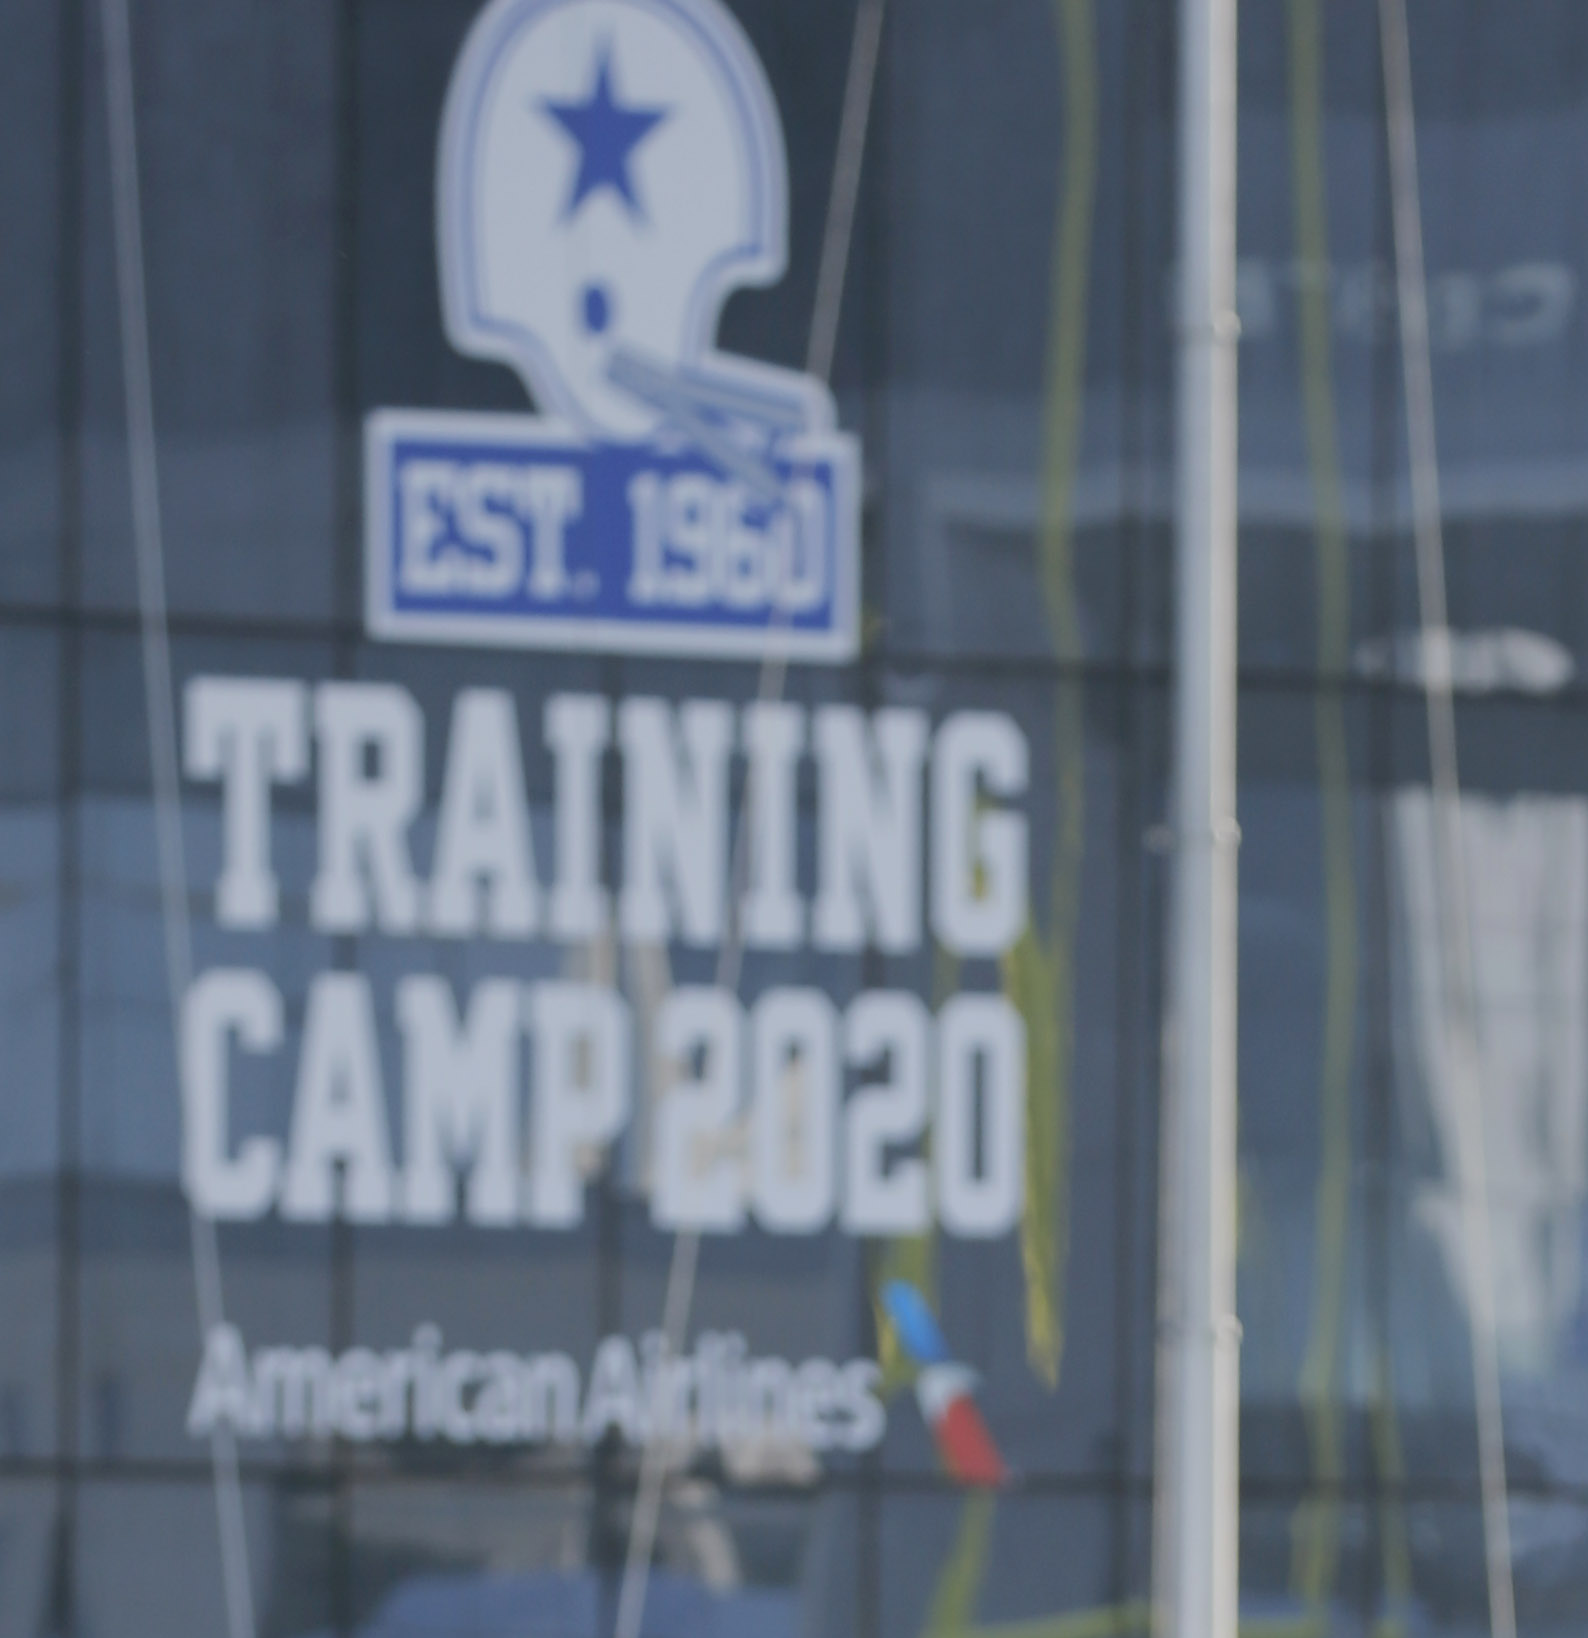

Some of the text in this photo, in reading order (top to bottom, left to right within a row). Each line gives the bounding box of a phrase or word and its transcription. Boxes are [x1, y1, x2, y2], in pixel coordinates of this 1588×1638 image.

[402, 457, 602, 599] EST.
[184, 675, 1030, 956] TRAINING
[180, 969, 1029, 1238] CAMP 2020
